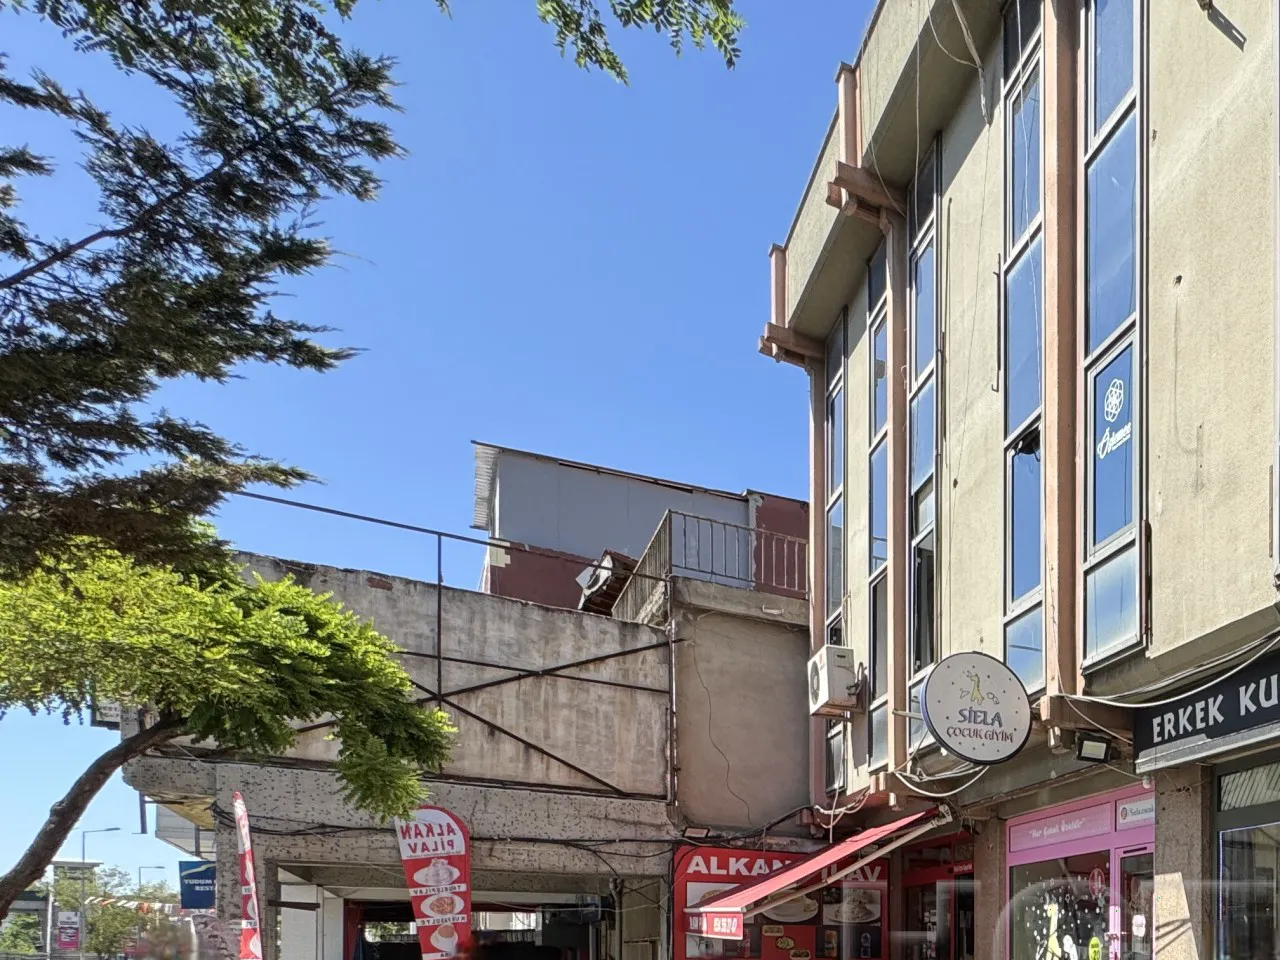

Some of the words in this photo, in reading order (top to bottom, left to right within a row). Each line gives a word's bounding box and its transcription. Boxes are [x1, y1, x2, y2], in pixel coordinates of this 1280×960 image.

[957, 706, 1004, 728] SİELA
[1151, 694, 1225, 744] ERKEK
[946, 725, 983, 740] ÇOCUK
[985, 727, 1014, 743] GİYİM
